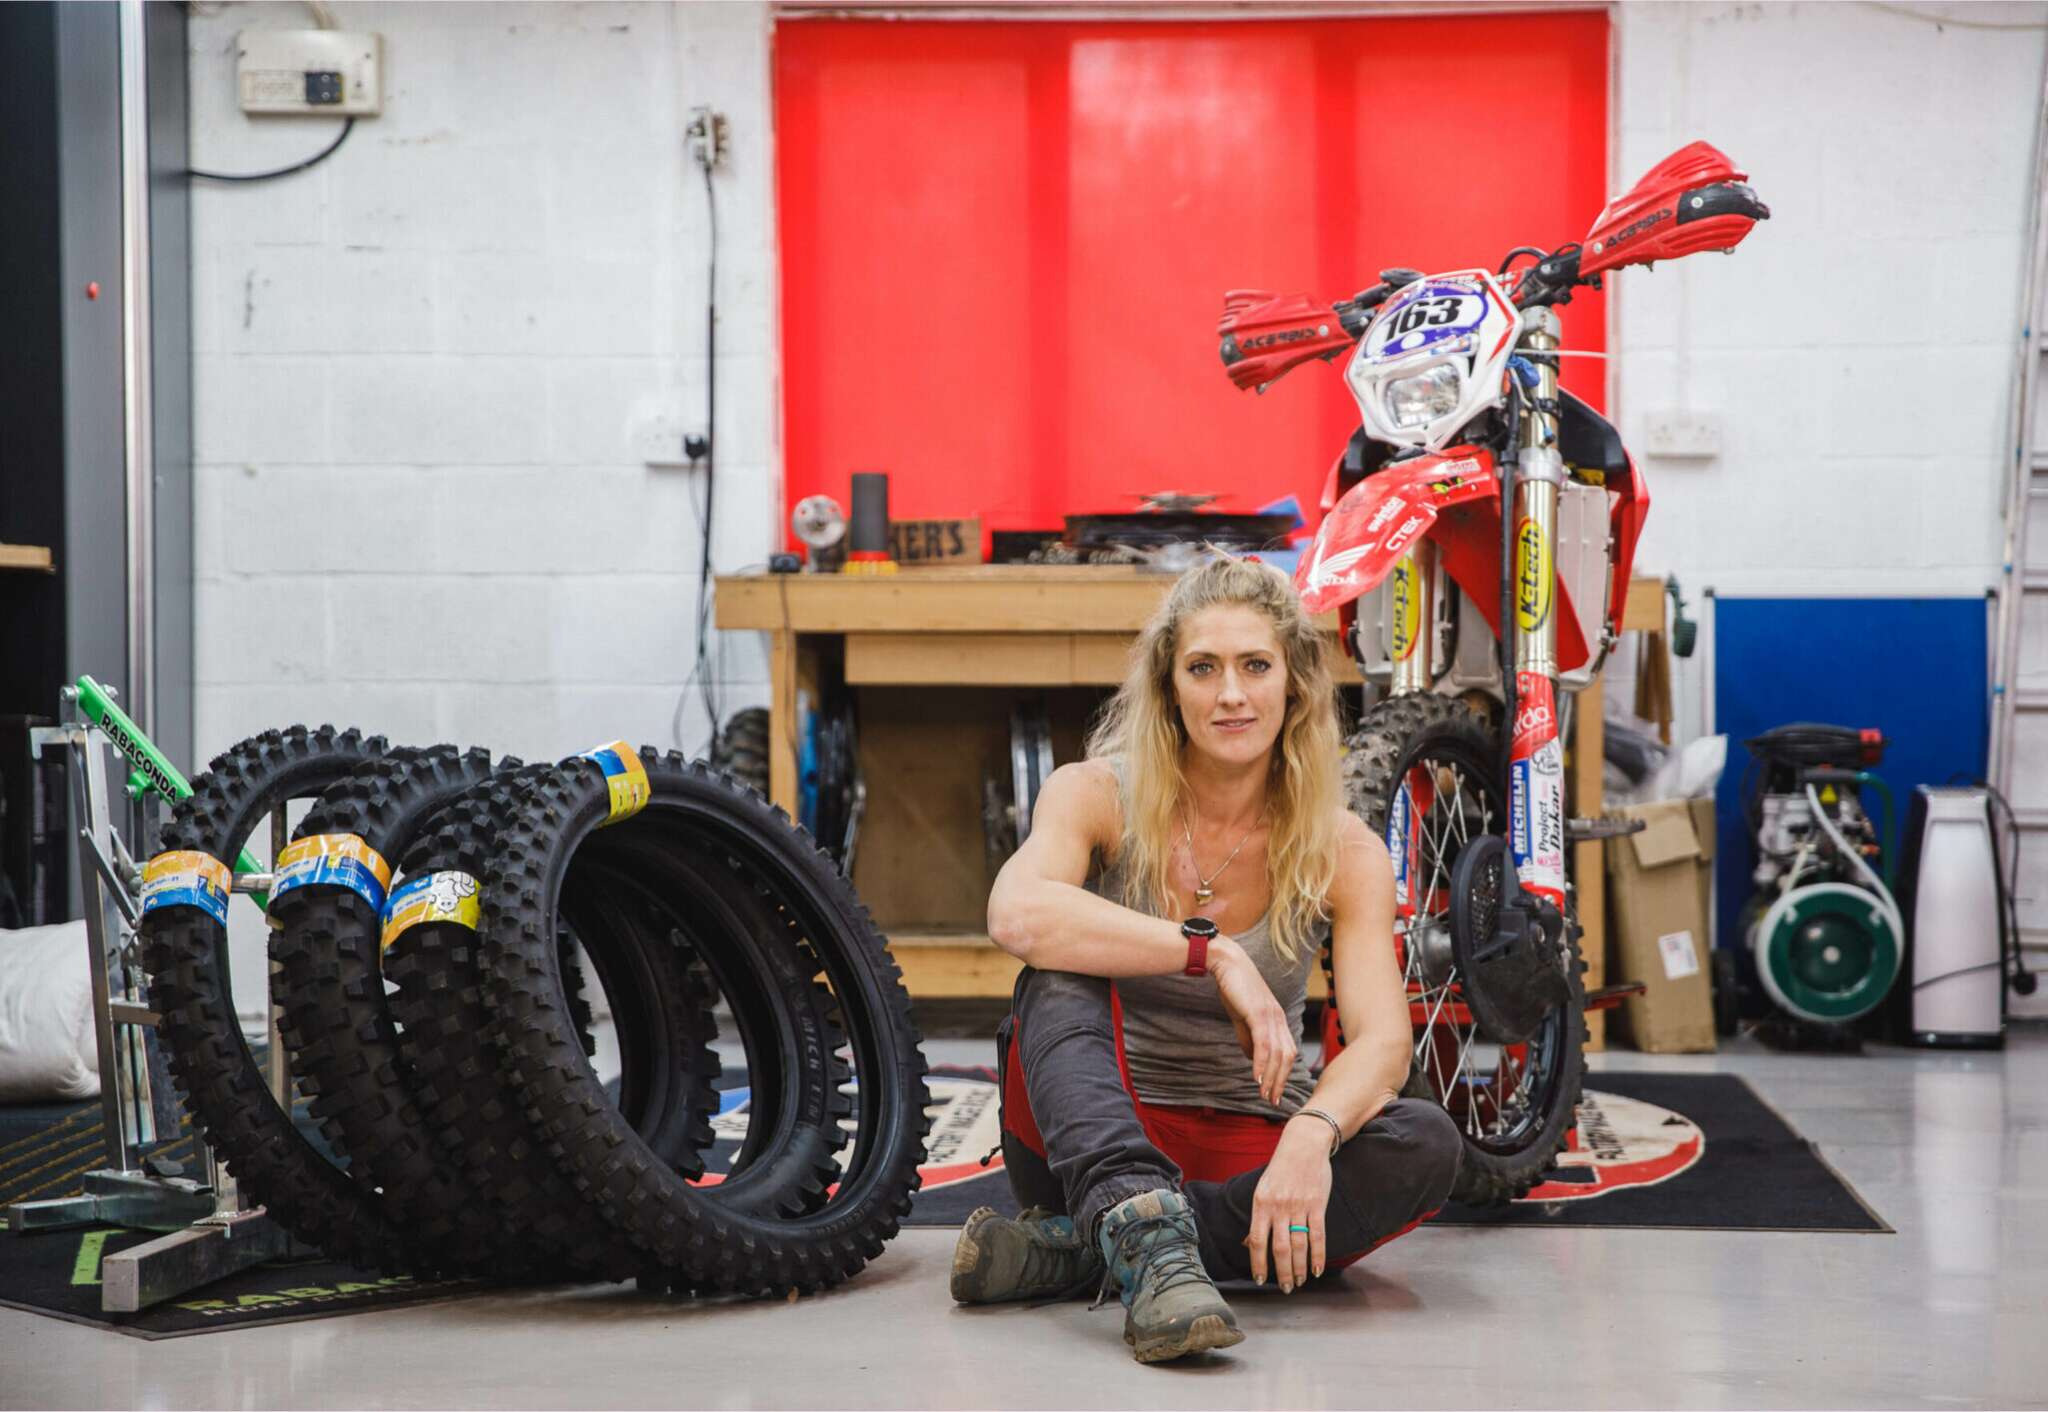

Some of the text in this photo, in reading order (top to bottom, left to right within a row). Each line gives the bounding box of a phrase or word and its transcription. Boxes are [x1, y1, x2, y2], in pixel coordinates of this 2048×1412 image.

[1606, 208, 1672, 249] ACERBIS
[1242, 327, 1316, 350] ACERBIS
[1386, 297, 1463, 342] 163
[1386, 516, 1424, 550] CTEK
[102, 713, 176, 804] RABACONDA
[1512, 765, 1527, 855] MICHELIN
[1537, 801, 1549, 853] Project
[1550, 784, 1561, 851] Dakar
